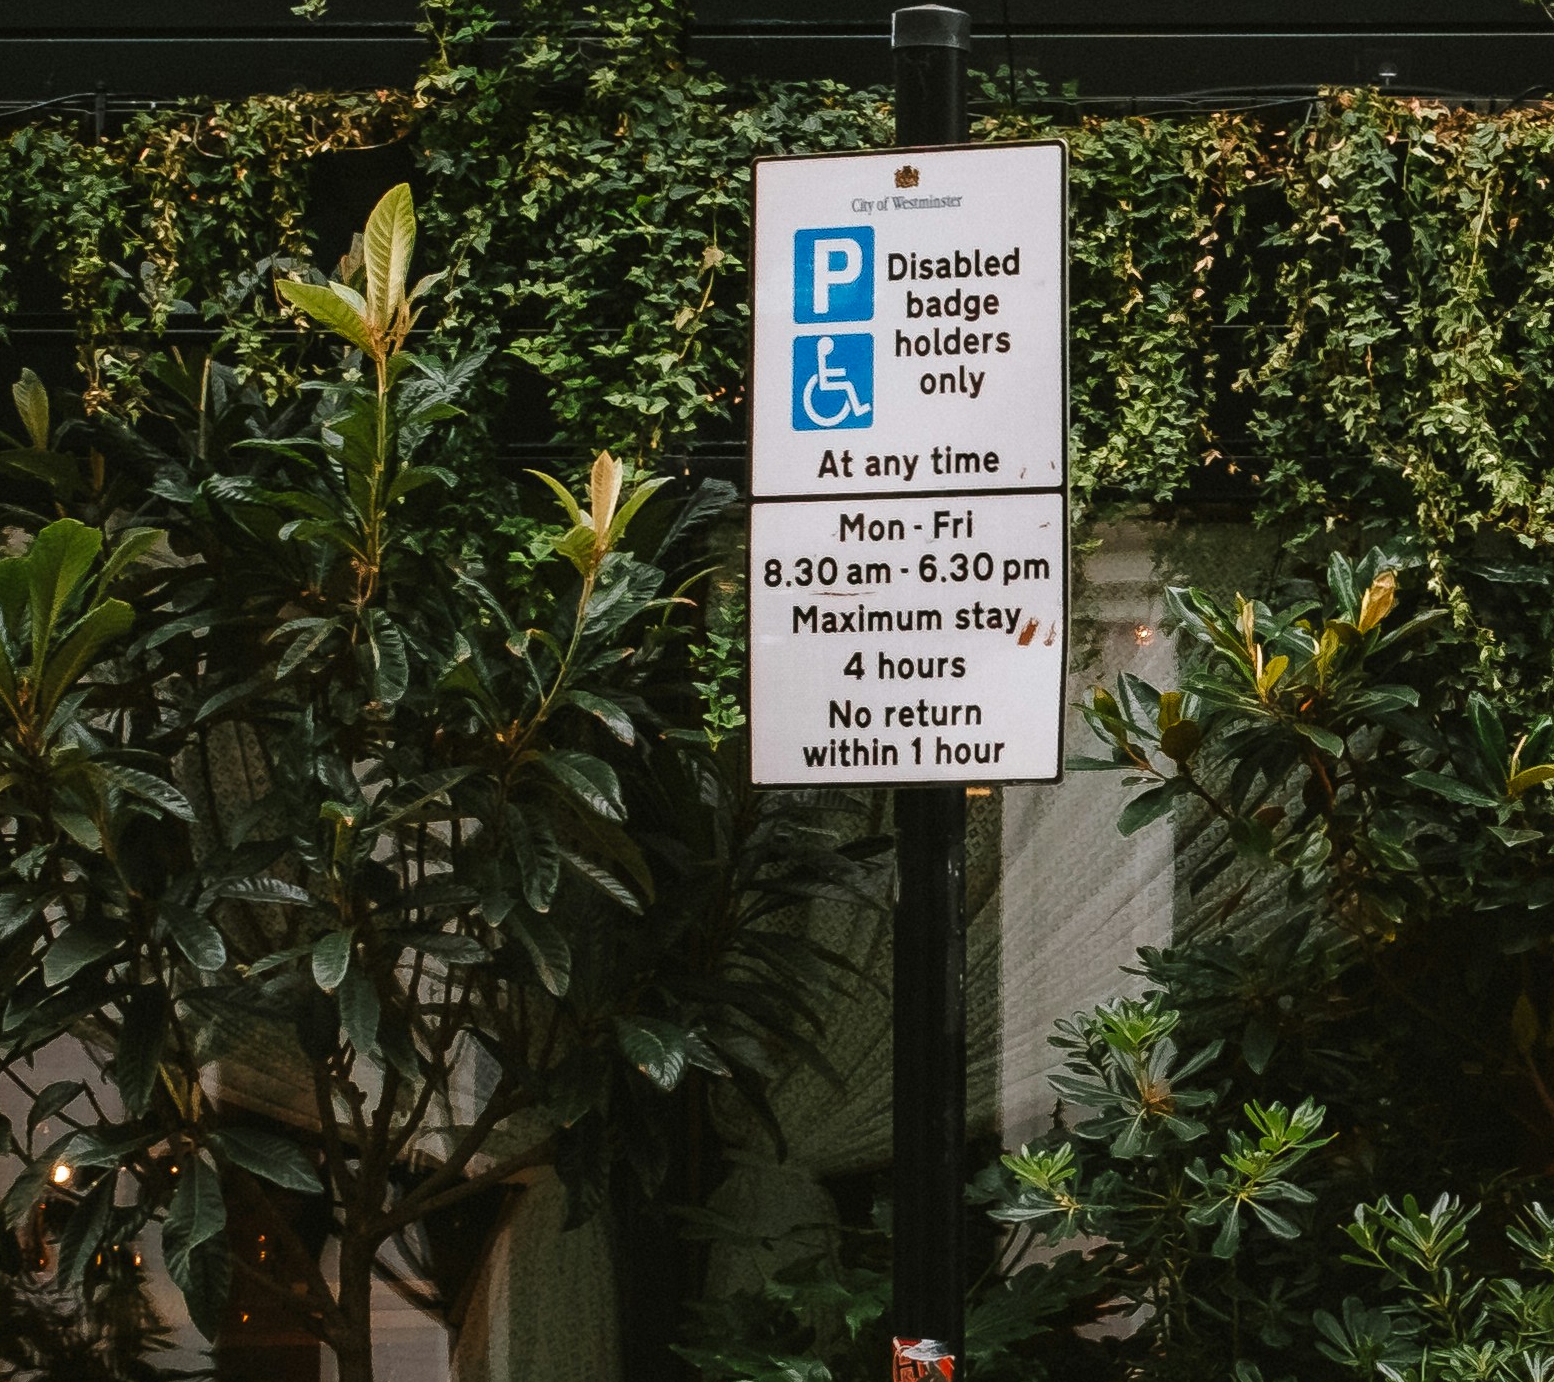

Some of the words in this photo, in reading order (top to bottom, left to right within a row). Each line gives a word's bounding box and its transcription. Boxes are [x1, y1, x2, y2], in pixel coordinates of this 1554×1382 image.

[852, 198, 874, 215] City
[877, 197, 889, 211] of
[892, 196, 962, 209] Westminster
[813, 238, 862, 314] P
[888, 247, 1019, 281] Disabled
[907, 289, 999, 321] badge
[896, 327, 1010, 357] holders
[920, 365, 985, 398] only
[818, 450, 853, 478] At
[865, 455, 918, 481] any
[931, 446, 999, 474] time
[840, 513, 904, 542] Mon
[934, 510, 972, 538] Fri
[764, 557, 837, 587] 8.30
[847, 563, 890, 585] am
[919, 552, 993, 582] 6.30
[1003, 559, 1049, 586] pm
[793, 604, 942, 633] Maximum
[955, 602, 1021, 635] stay
[844, 652, 865, 680] 4
[879, 652, 965, 679] hours
[830, 700, 871, 728] No
[885, 699, 981, 727] return
[803, 738, 898, 767] within
[912, 737, 921, 764] 1
[936, 737, 1004, 764] hour
